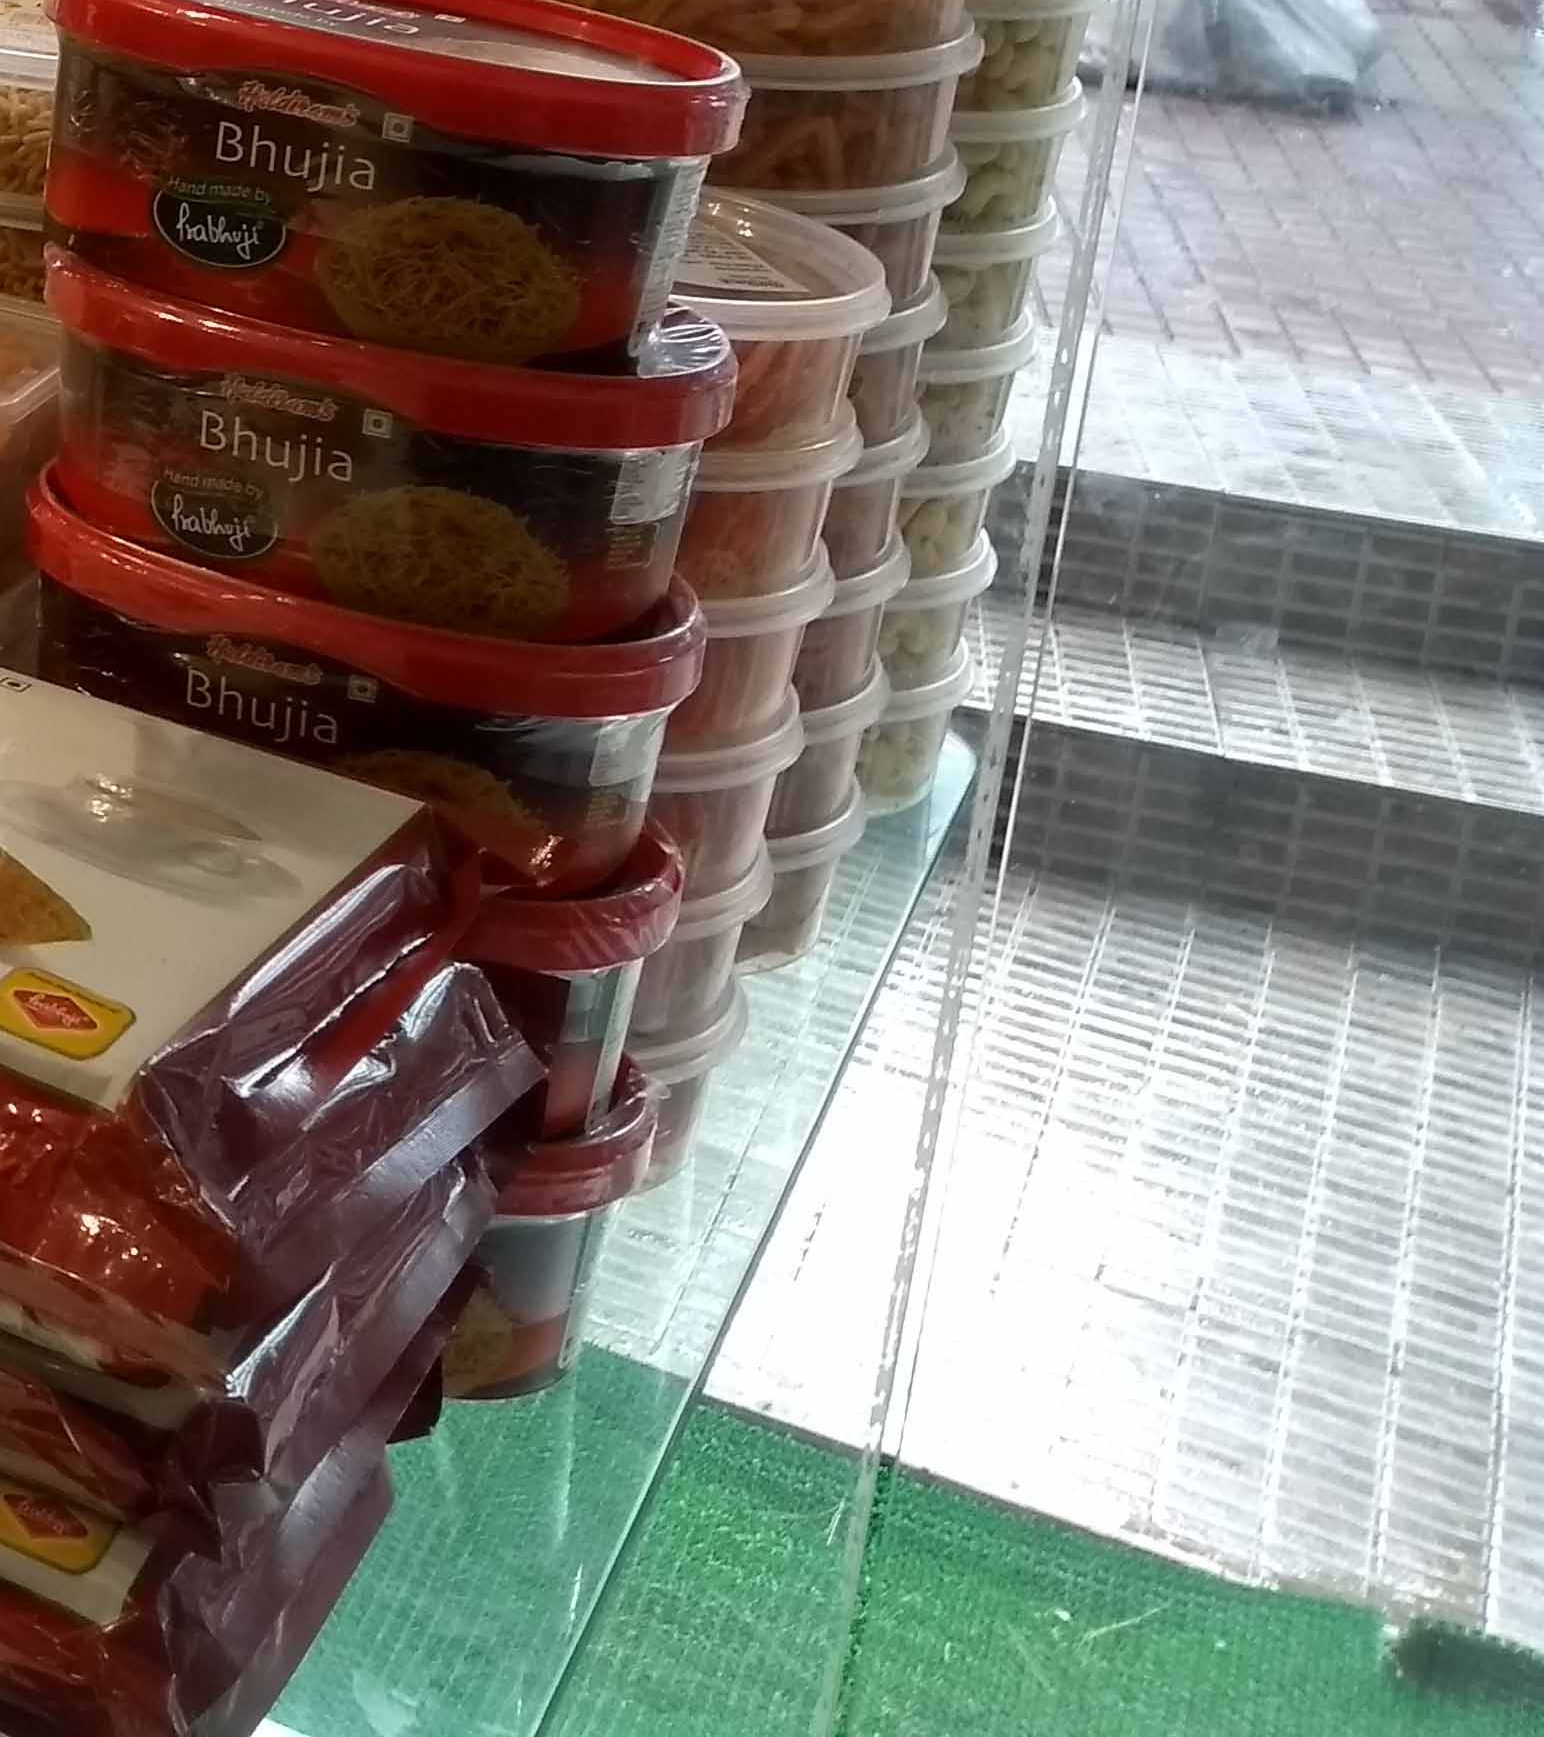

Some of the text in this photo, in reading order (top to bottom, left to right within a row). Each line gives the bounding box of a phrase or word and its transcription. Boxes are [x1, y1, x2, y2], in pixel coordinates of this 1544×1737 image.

[167, 176, 272, 205] Hand made by
[215, 120, 376, 193] Bhujia
[199, 409, 353, 483] Bhujia
[163, 467, 200, 488] Hand
[245, 482, 264, 500] by
[186, 665, 339, 744] Bhujia
